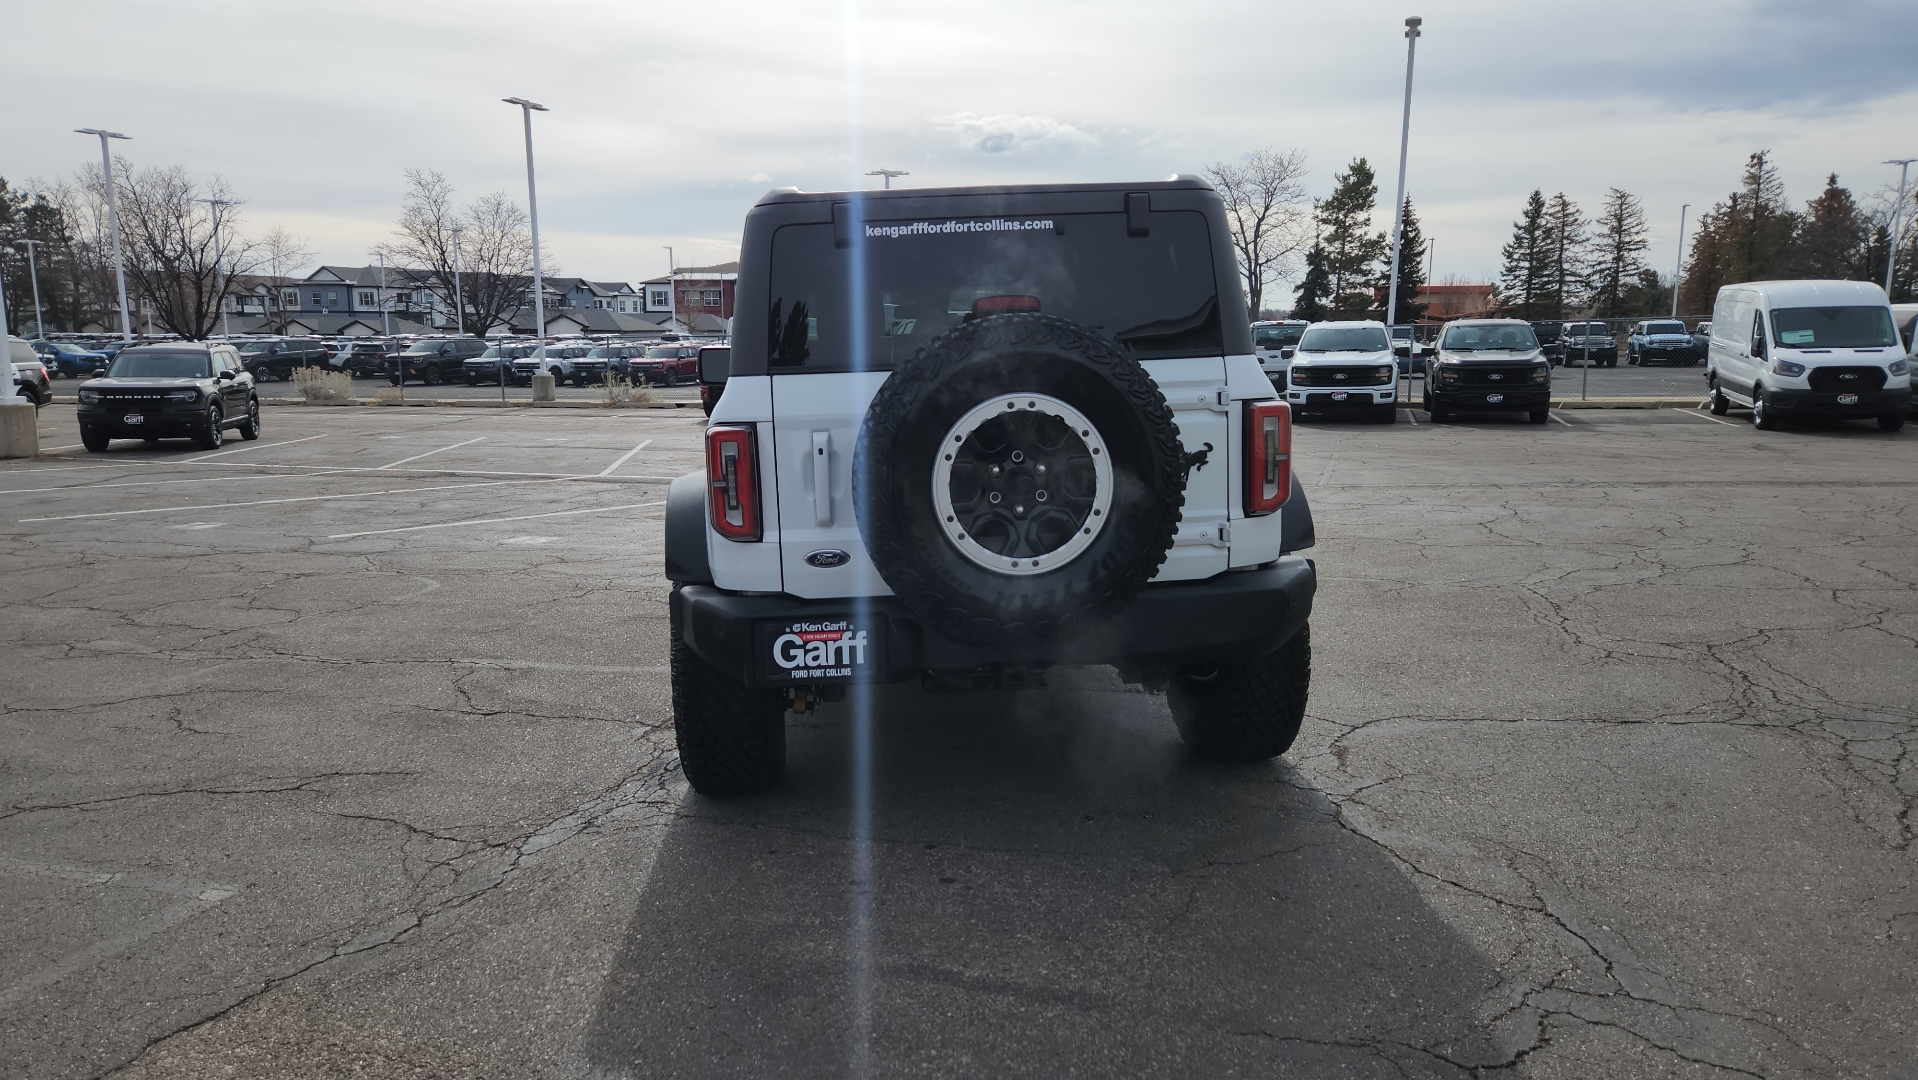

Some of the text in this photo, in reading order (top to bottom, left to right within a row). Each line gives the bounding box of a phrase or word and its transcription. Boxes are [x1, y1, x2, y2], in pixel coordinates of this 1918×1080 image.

[865, 219, 1054, 238] kengarfffordfortcollins.com
[801, 621, 847, 632] Ken Garff
[773, 630, 867, 669] Garff
[791, 668, 852, 679] FORD FORT COLLINS
